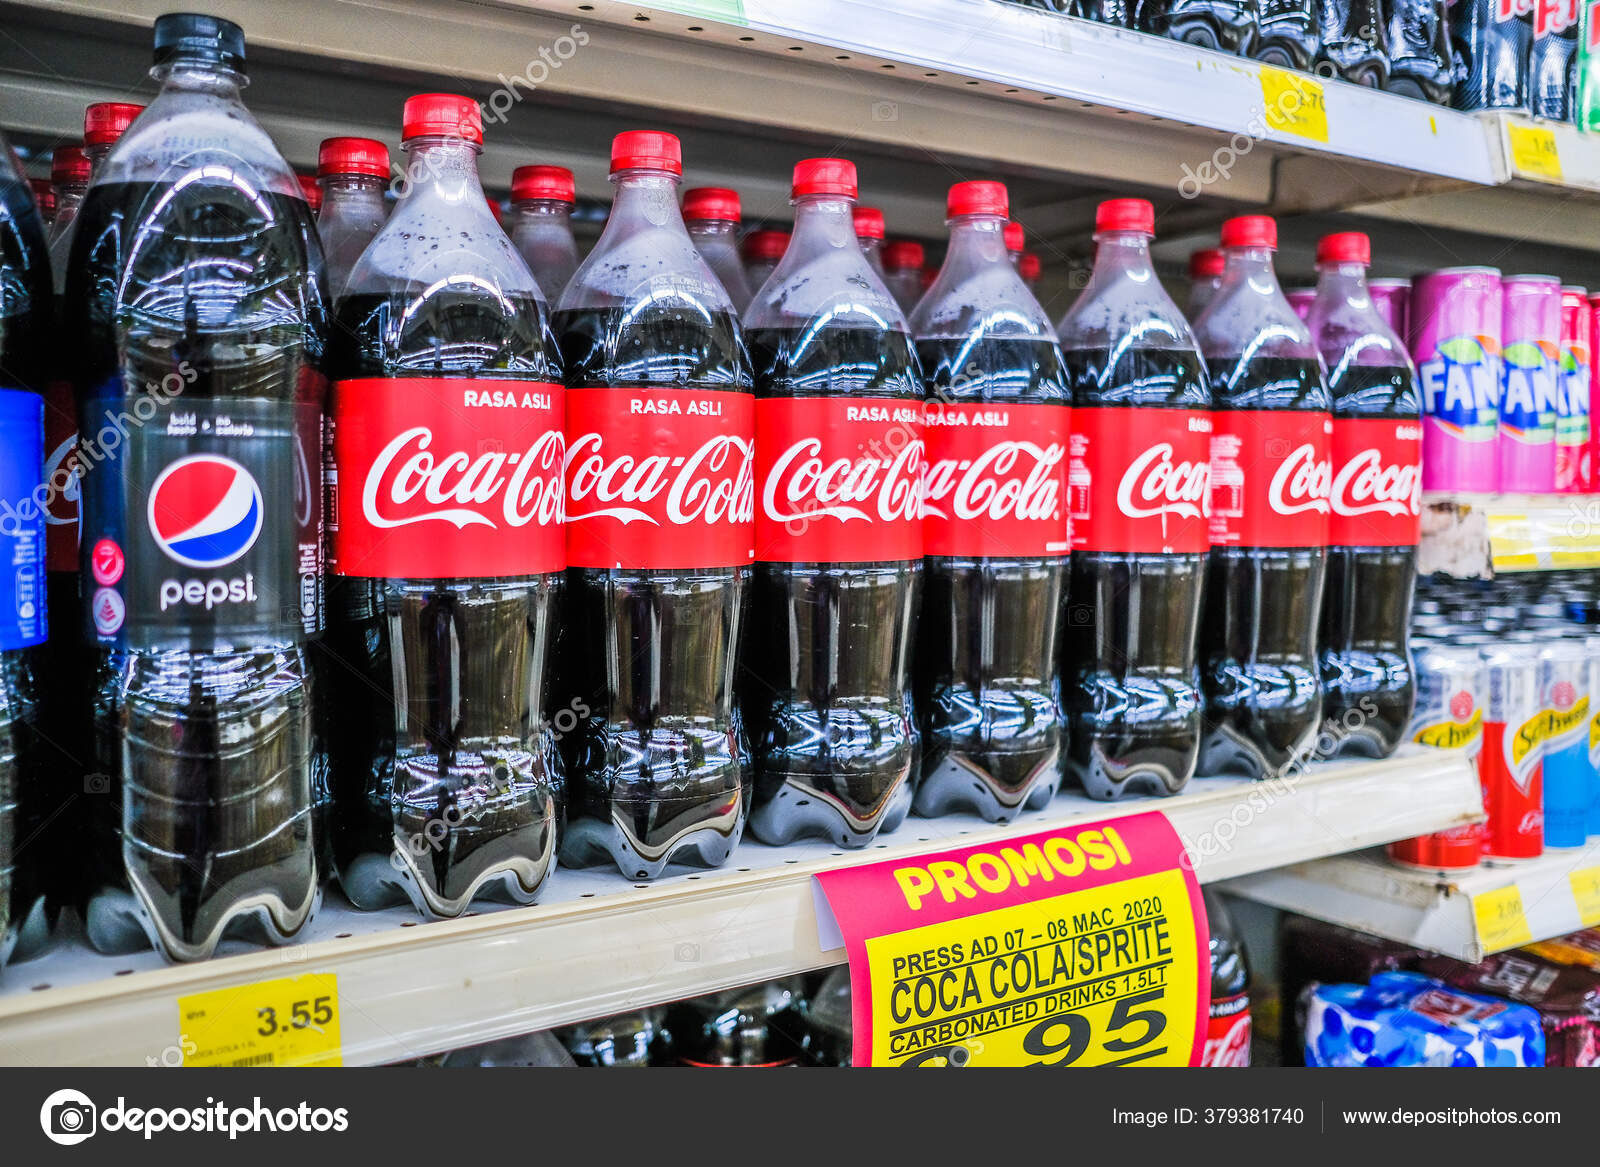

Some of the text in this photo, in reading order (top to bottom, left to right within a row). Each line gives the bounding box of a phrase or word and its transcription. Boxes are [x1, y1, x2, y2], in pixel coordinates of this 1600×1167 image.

[464, 390, 551, 410] RASA ASLI
[1420, 356, 1499, 414] FAN
[630, 399, 722, 416] RASA ASLI
[847, 406, 889, 422] RASA
[972, 412, 1009, 427] ASLI
[160, 573, 253, 611] pepsi
[893, 826, 1132, 911] PROMOSI
[893, 946, 965, 978] PRESS
[970, 936, 999, 961] AD
[1005, 928, 1025, 952] 07
[1047, 918, 1069, 942] 08
[1073, 907, 1115, 935] MAC
[1124, 895, 1162, 921] 2020
[891, 917, 1172, 1024] COCA COLA/SPRITE
[257, 995, 333, 1037] 3.55
[890, 966, 1168, 1054] CARBONATED DRINKS 1.5LT
